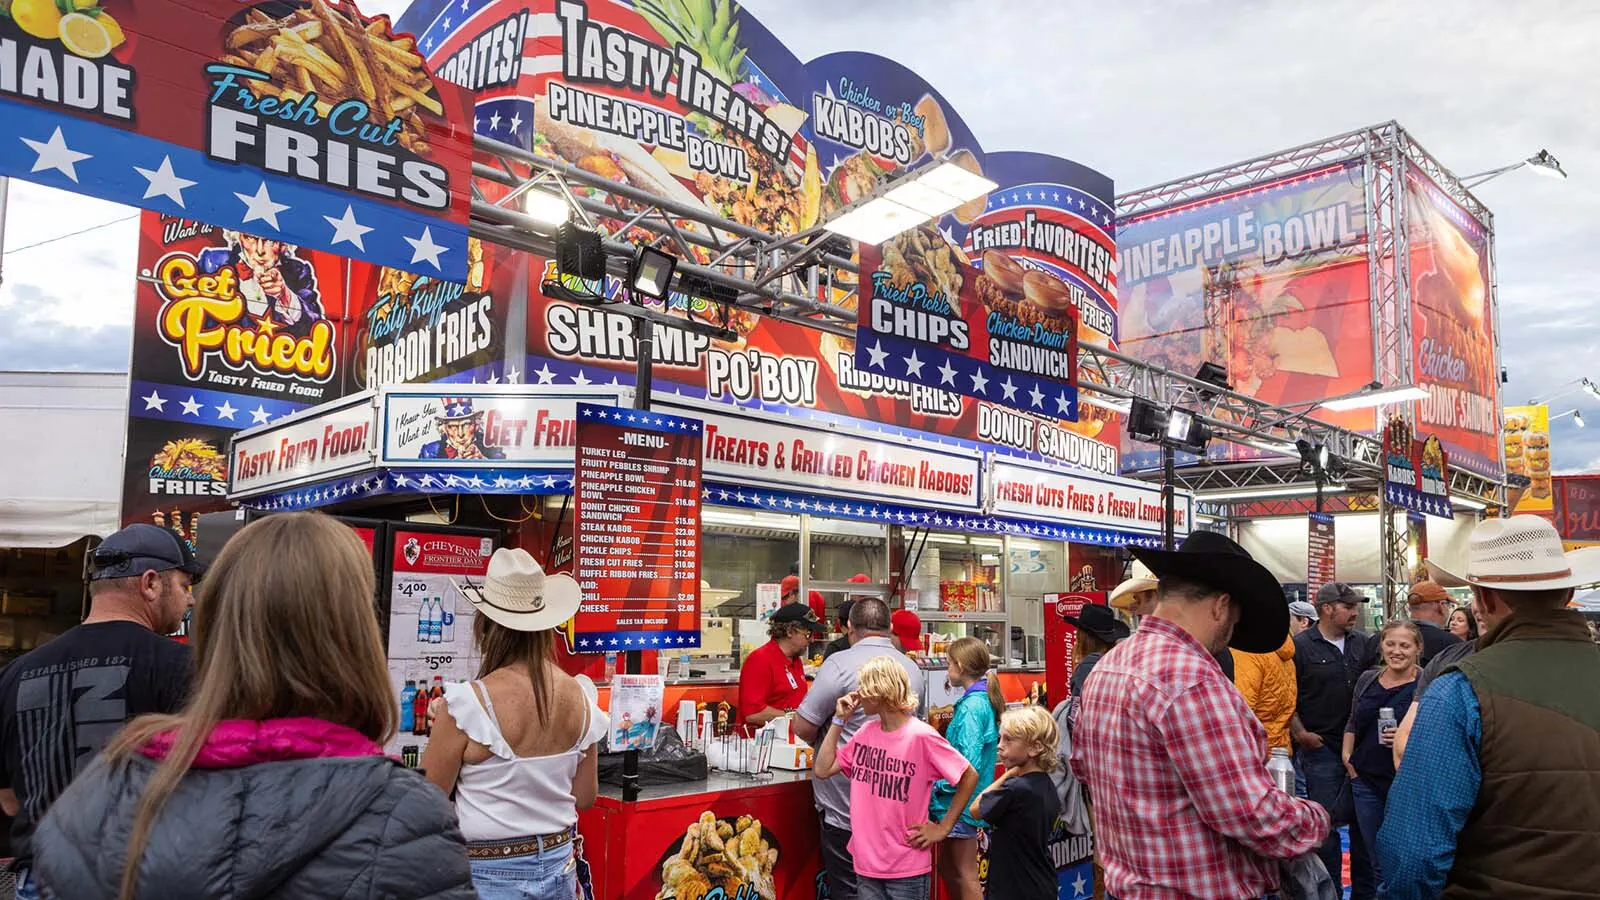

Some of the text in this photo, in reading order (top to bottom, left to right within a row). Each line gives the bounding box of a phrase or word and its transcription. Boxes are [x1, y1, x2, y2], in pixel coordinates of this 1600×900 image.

[436, 12, 527, 90] ORITES!
[560, 1, 793, 163] TASTY TREATS!
[206, 64, 404, 147] Fresh Cut
[840, 76, 927, 138] Chicken or Beef
[550, 82, 750, 181] PINEAPPLE BOWL
[814, 95, 911, 164] KABOBS
[211, 104, 449, 208] FRIES
[164, 218, 198, 243] Want
[1262, 202, 1357, 264] BOWL
[972, 212, 1111, 291] FRIED FAVORITES!
[160, 258, 237, 298] Get
[871, 272, 950, 316] Fried Pickle
[367, 294, 407, 346] Tasty
[549, 306, 709, 365] SHRMP
[871, 298, 969, 350] CHIPS
[986, 311, 1031, 341] Chicken
[1083, 302, 1112, 337] FRIES
[164, 295, 332, 382] Fried
[365, 295, 492, 391] RIBBON FRIES
[989, 337, 1069, 379] SANDWICH
[1418, 338, 1465, 382] Chicken
[208, 369, 324, 398] TASTY FRIED FOOD!
[708, 350, 816, 403] PO'BOY
[400, 413, 421, 428] Know
[423, 402, 438, 418] You
[912, 382, 961, 416] FRIES
[1420, 382, 1458, 427] DONUT
[398, 419, 433, 448] Want it!
[484, 408, 527, 448] GET
[979, 404, 1117, 475] DONUT SANDWICH
[238, 421, 370, 482] TASTY FRIED FOOD!
[581, 446, 697, 467] TURKEY LEG $20.00
[581, 458, 670, 474] FRUITY PEBBLES SHRIMP
[705, 424, 974, 496] TREATS & GRILLED CHICKEN KABOBS!
[149, 465, 213, 480] Chili Cheese
[149, 478, 228, 496] FRIES
[581, 470, 624, 481] PINEAPPLE
[625, 474, 645, 483] BOWL
[581, 481, 656, 495] PINEAPPLE CHICKEN
[581, 490, 604, 500] BOWL
[581, 502, 640, 513] DONUT CHICKEN
[997, 480, 1033, 503] FRESH
[1036, 484, 1064, 509] CUTS
[1067, 485, 1095, 513] FRIES
[1097, 494, 1104, 514] &
[1107, 491, 1136, 518] FRESH
[1138, 497, 1185, 526] LEMODE!
[580, 522, 696, 536] STEAK KABOB $23.00
[581, 511, 696, 525] SANDWICH $15.00
[424, 541, 481, 558] CHEYENN
[580, 534, 614, 543] CHICKEN
[615, 535, 640, 545] KABOB
[580, 546, 696, 558] PICKLE CHIPS $12.00
[424, 555, 461, 564] FRONTIER
[464, 558, 483, 566] DAYS
[580, 557, 695, 569] FRESH CUT FRIES $10.00
[580, 569, 695, 580] RUFFLE RIBBON FRIES $12.00
[580, 581, 599, 590] ADD:
[580, 592, 695, 602] CHILI $2.00
[580, 604, 695, 613] CHEESE $2.00
[1057, 602, 1083, 614] Commun
[21, 658, 98, 679] ESTABLISHED
[853, 742, 916, 777] TOUGH GUYS
[871, 771, 911, 804] PINK!
[1047, 831, 1094, 869] ONADE
